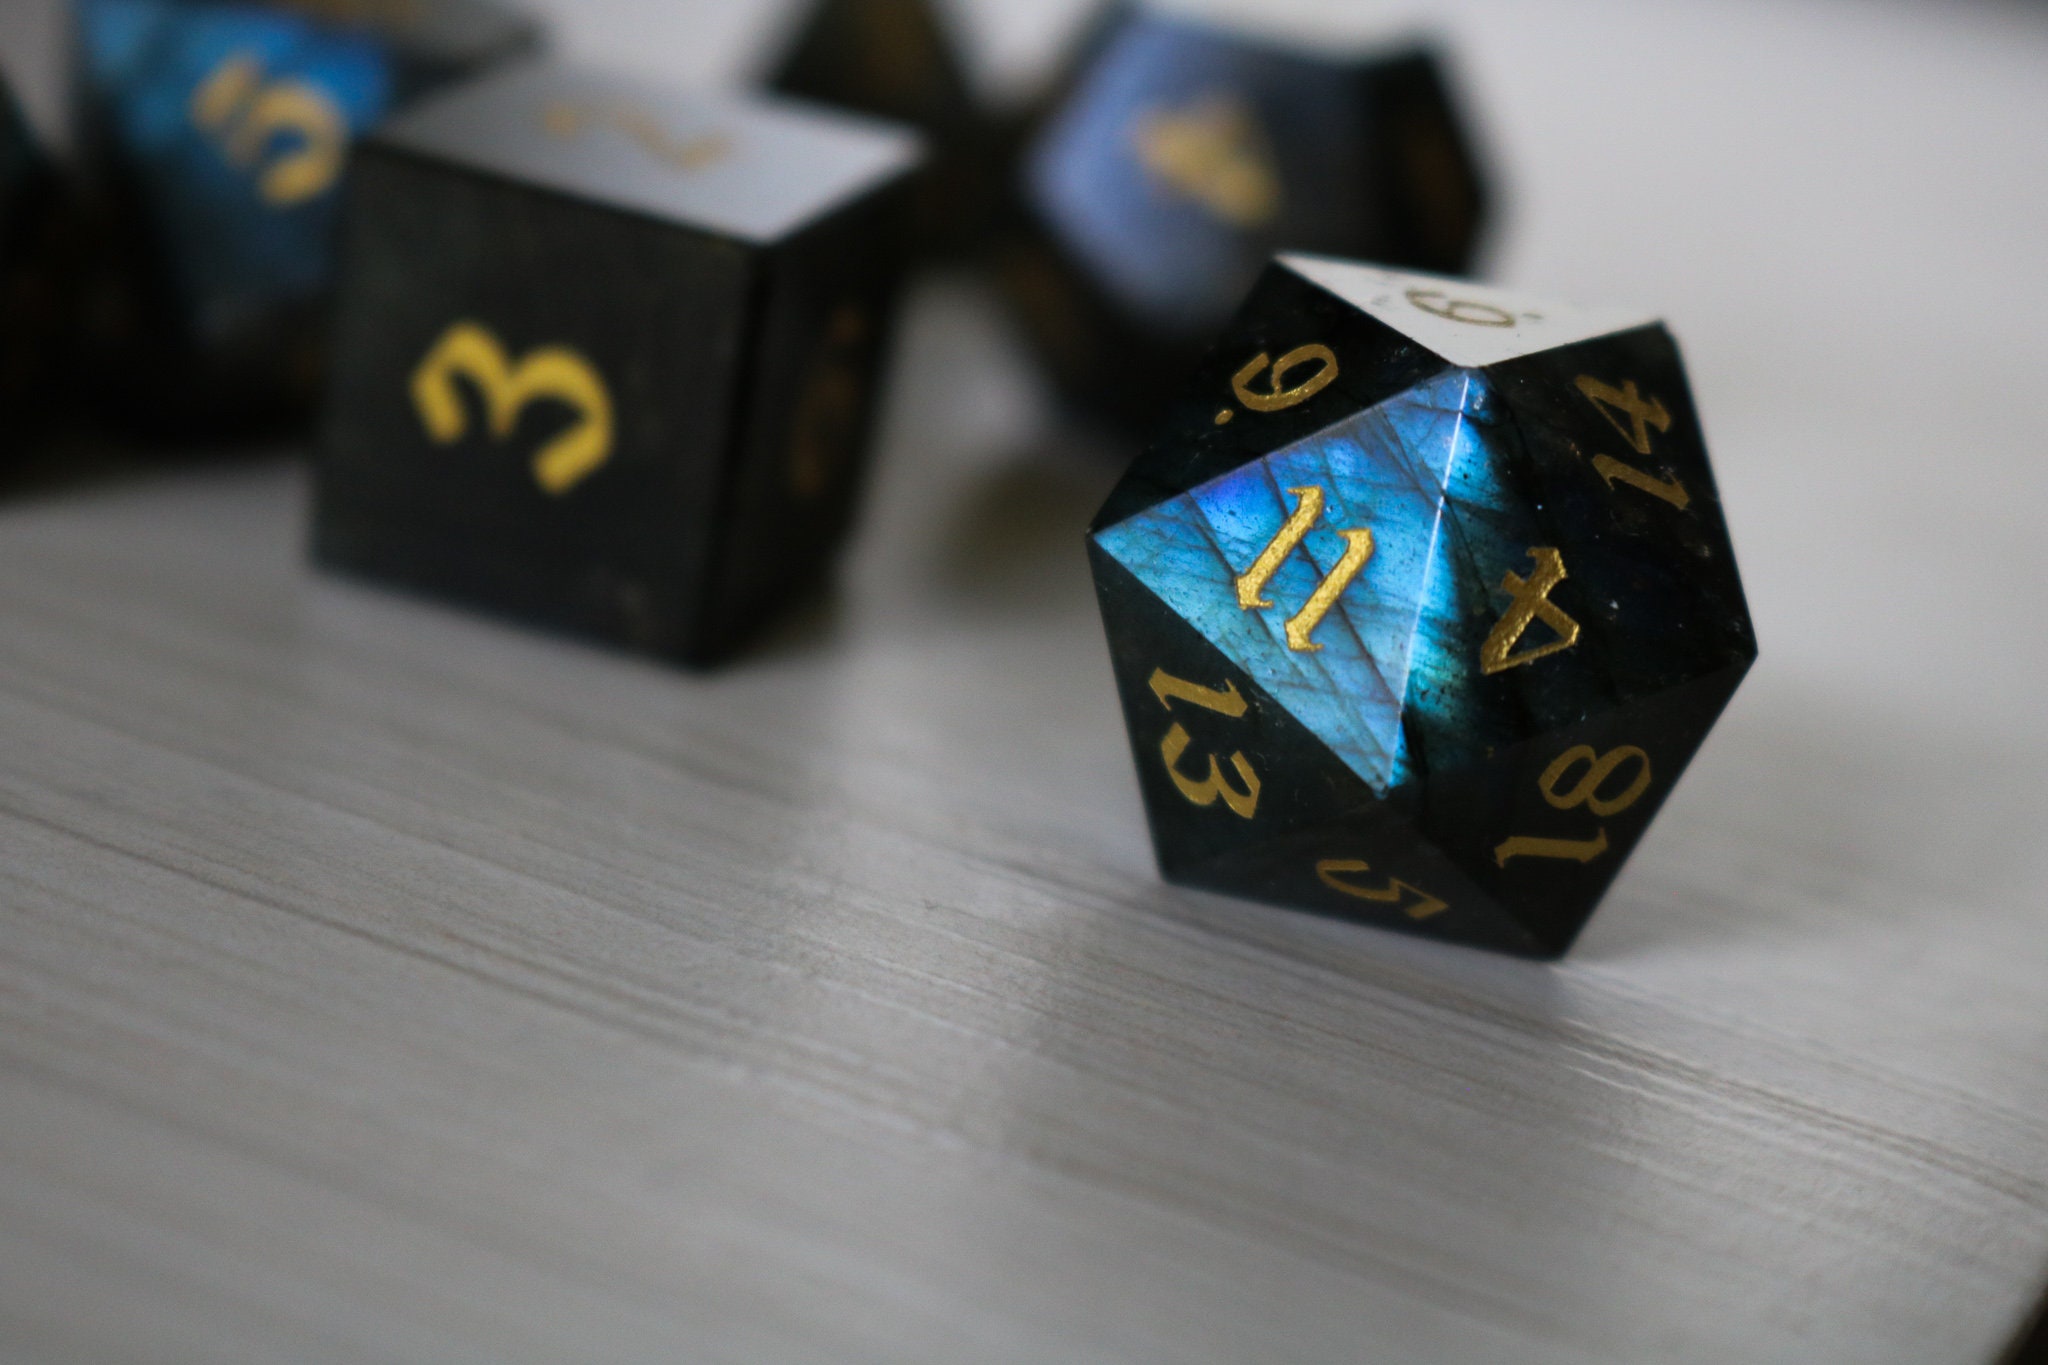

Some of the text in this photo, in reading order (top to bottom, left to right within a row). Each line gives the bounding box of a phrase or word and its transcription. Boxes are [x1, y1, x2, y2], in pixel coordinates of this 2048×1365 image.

[412, 323, 612, 494] 3
[1575, 375, 1691, 511] 14
[1234, 485, 1374, 653] 11
[1480, 546, 1582, 676] 4
[1147, 666, 1263, 821] 13
[1494, 743, 1653, 867] 18
[1316, 857, 1449, 920] 5
